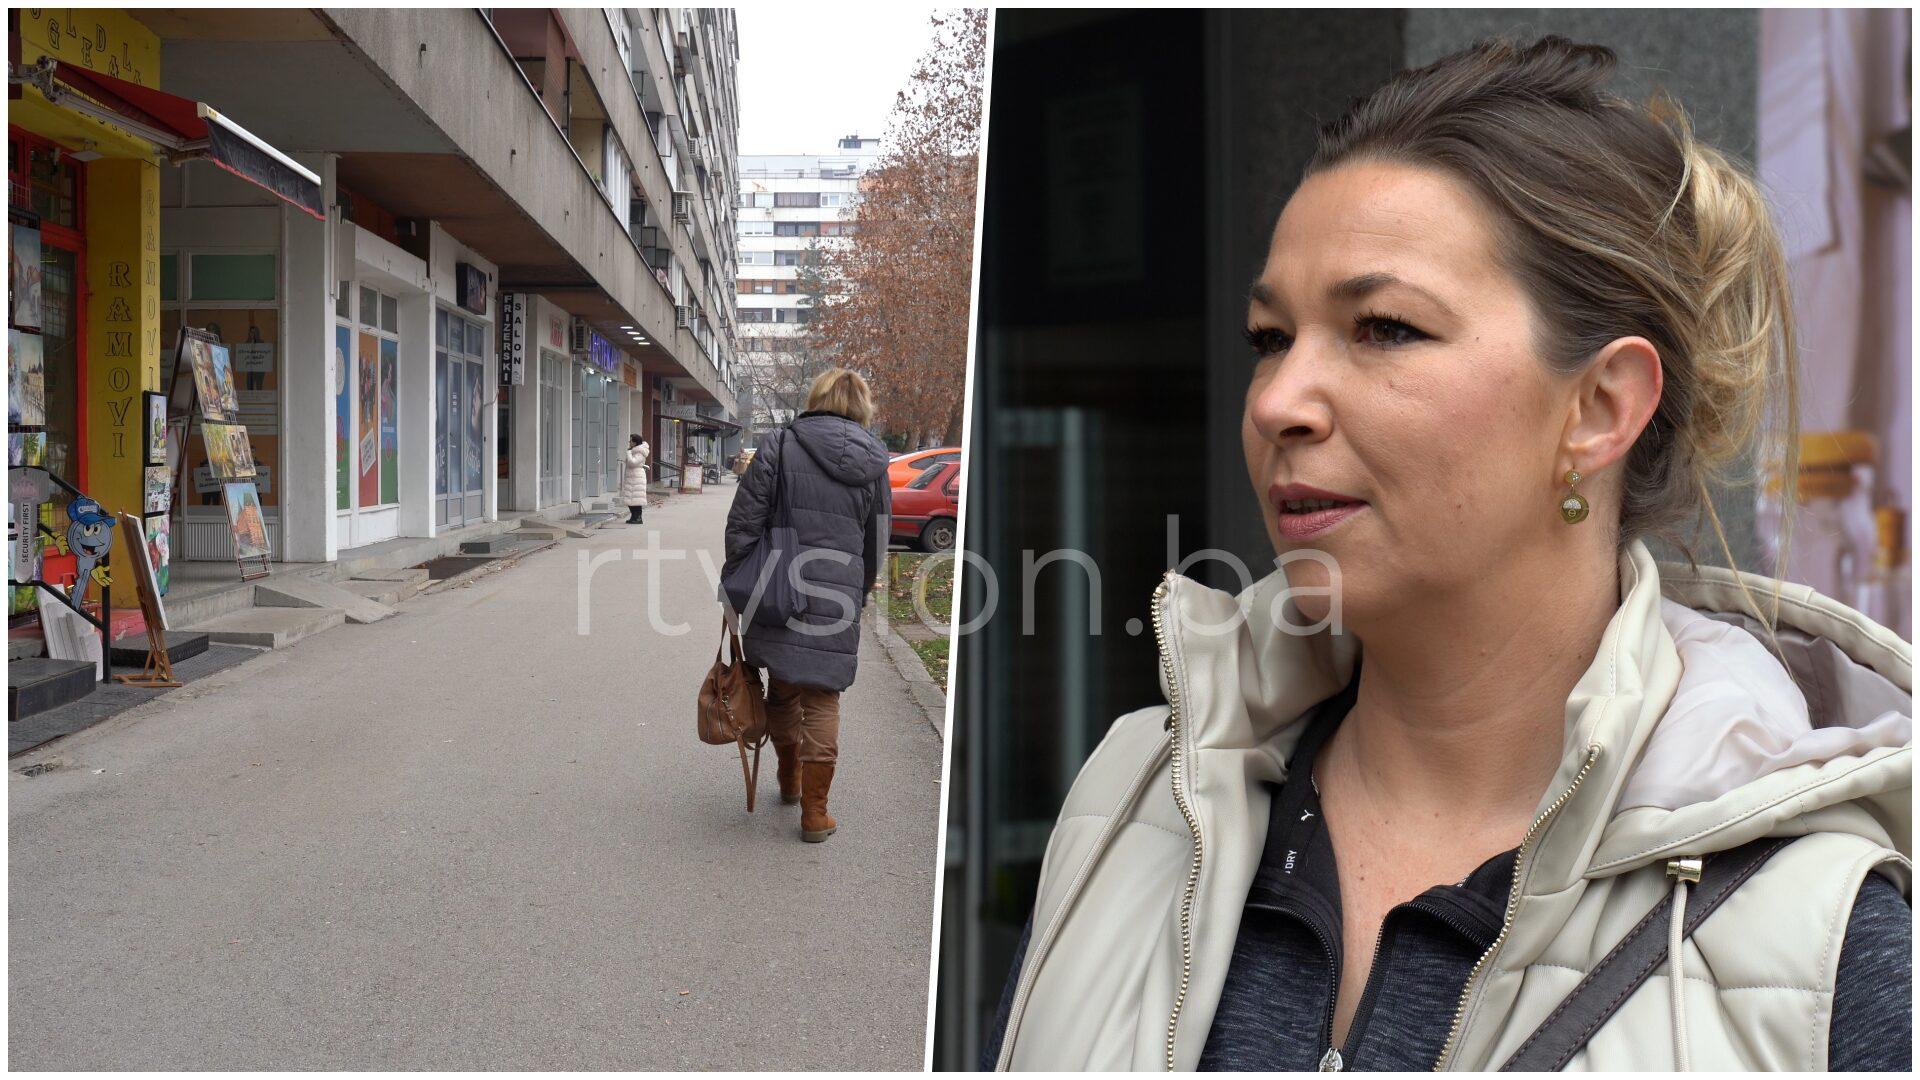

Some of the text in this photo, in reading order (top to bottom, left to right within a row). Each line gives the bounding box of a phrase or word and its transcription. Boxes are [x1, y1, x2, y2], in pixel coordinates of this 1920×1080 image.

[104, 260, 133, 458] RAMOVI
[503, 295, 513, 381] FRIZERSKI
[513, 303, 522, 365] SALON
